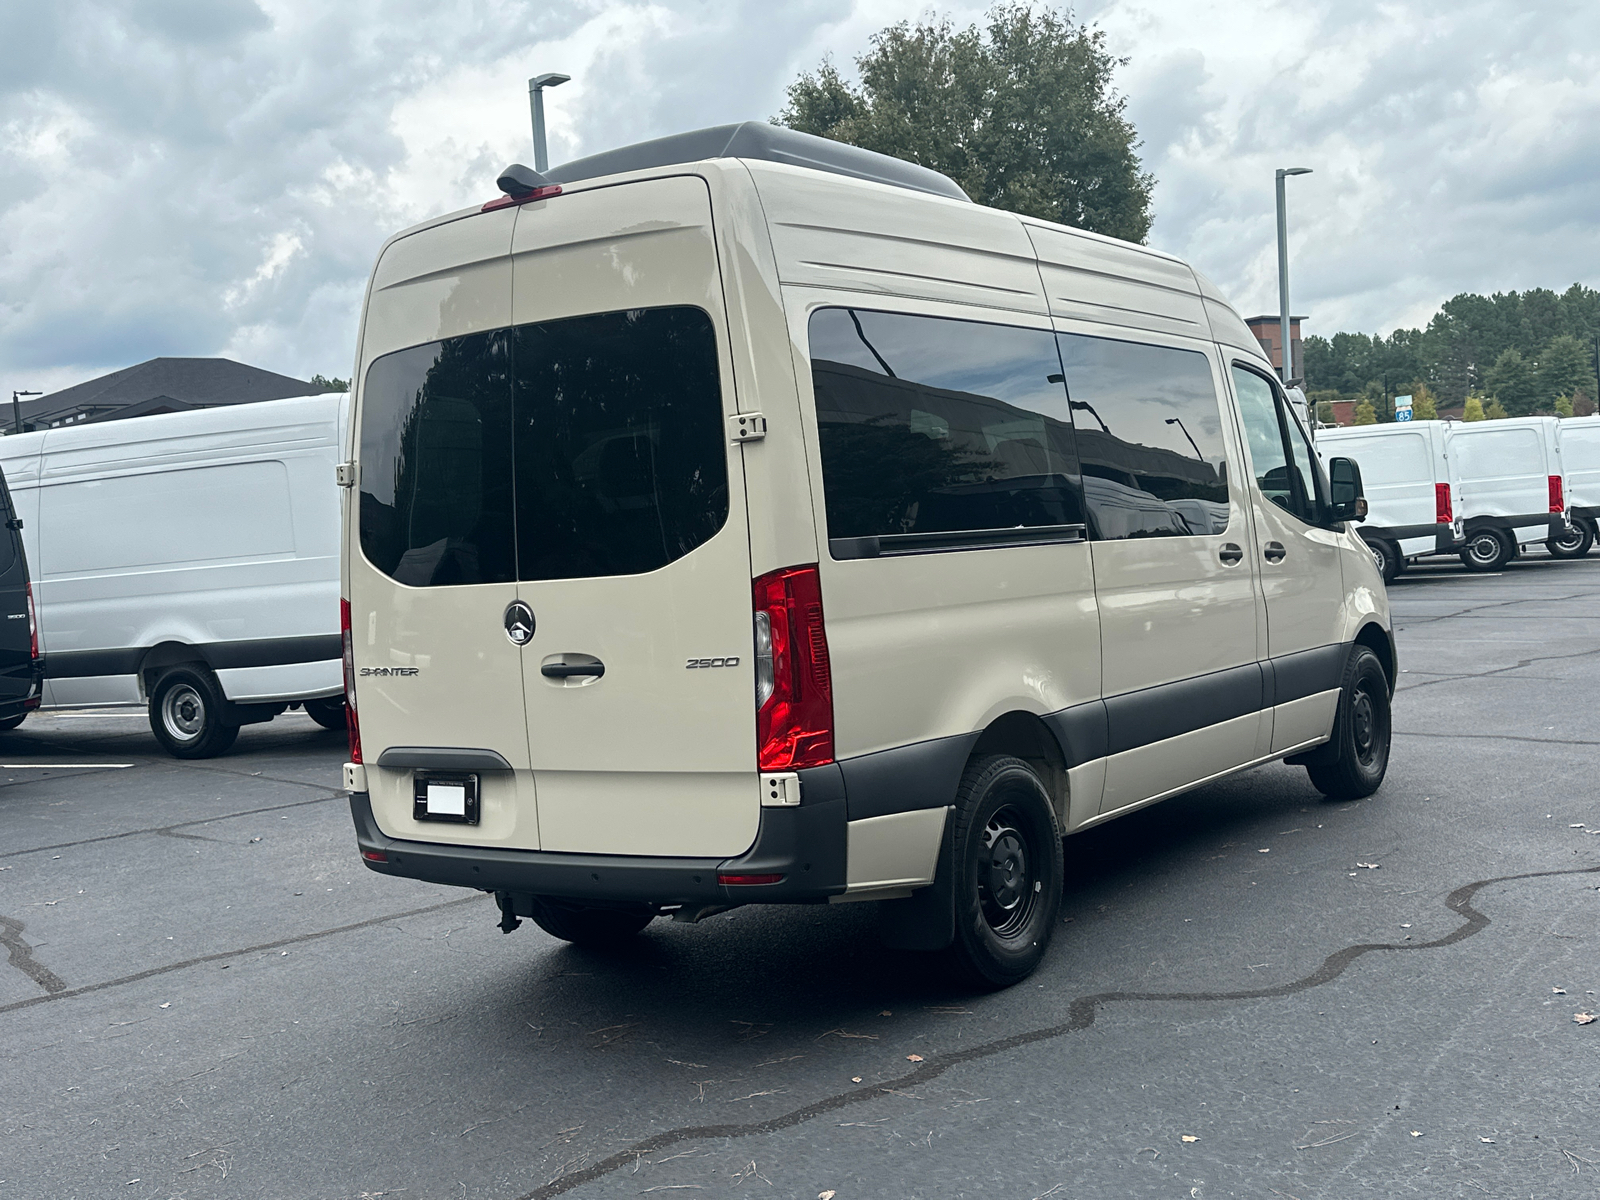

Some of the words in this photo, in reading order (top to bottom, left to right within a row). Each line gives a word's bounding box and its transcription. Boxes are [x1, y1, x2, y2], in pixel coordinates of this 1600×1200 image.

[1398, 411, 1410, 422] 85
[685, 656, 740, 669] 2500
[359, 667, 420, 677] SPRINTER
